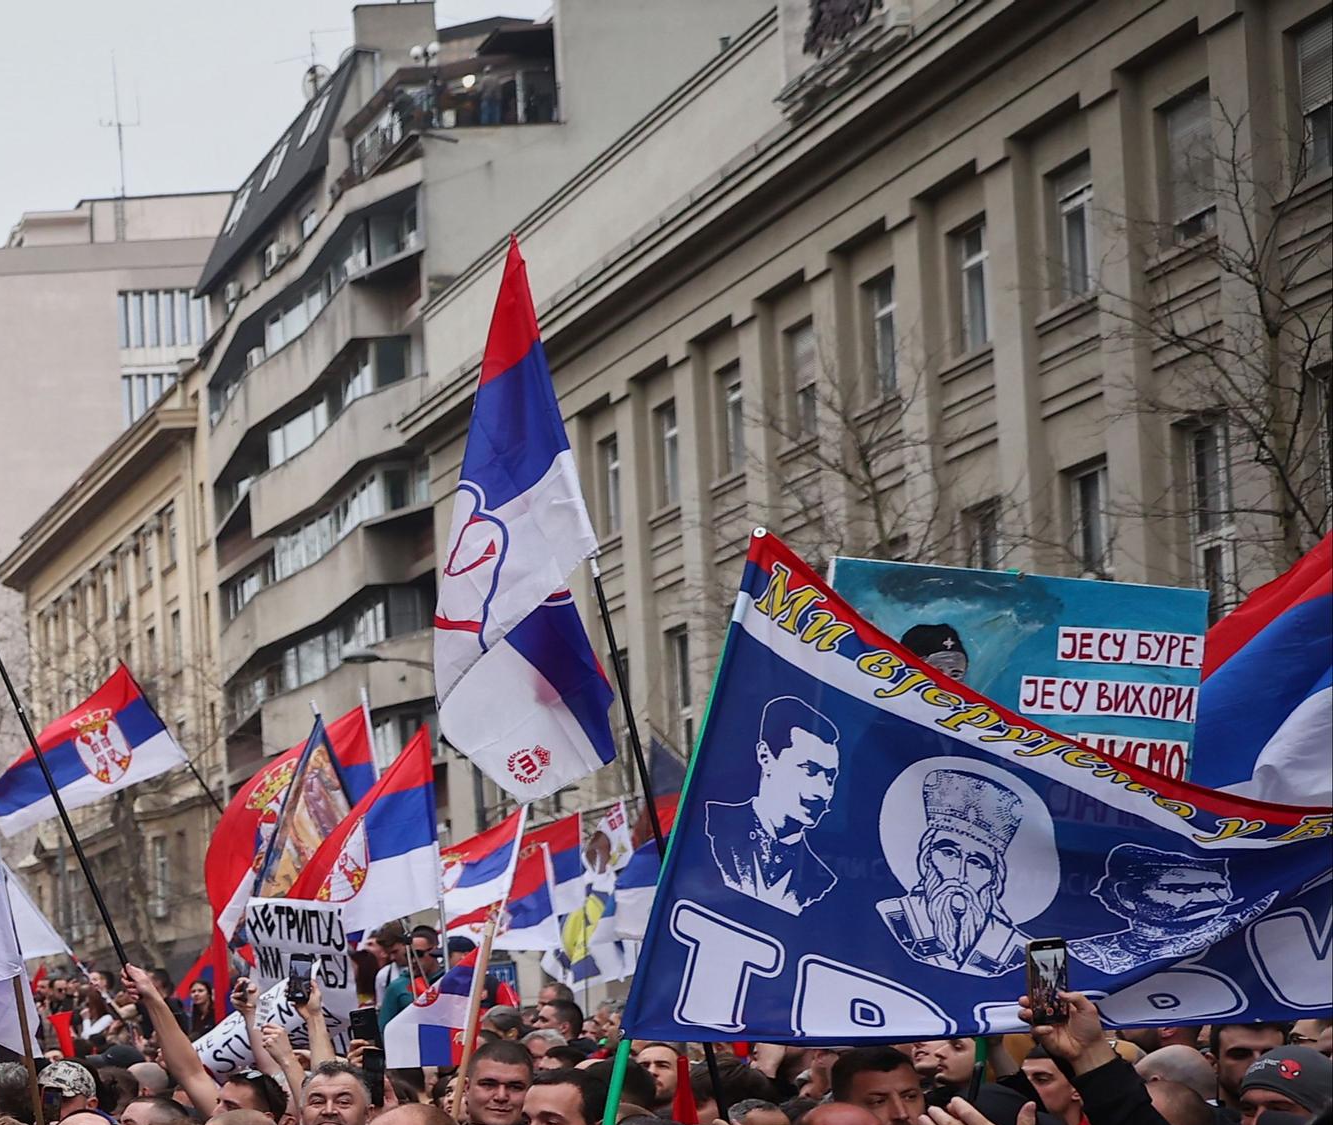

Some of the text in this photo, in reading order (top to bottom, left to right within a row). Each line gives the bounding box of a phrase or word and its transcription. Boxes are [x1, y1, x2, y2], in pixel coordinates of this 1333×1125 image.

[754, 562, 853, 652] Ми
[1060, 632, 1203, 667] ЈЕСУ БУРЕ.
[1022, 678, 1195, 723] ЈЕСУ ВИХОРИ.
[255, 946, 283, 979] МИ
